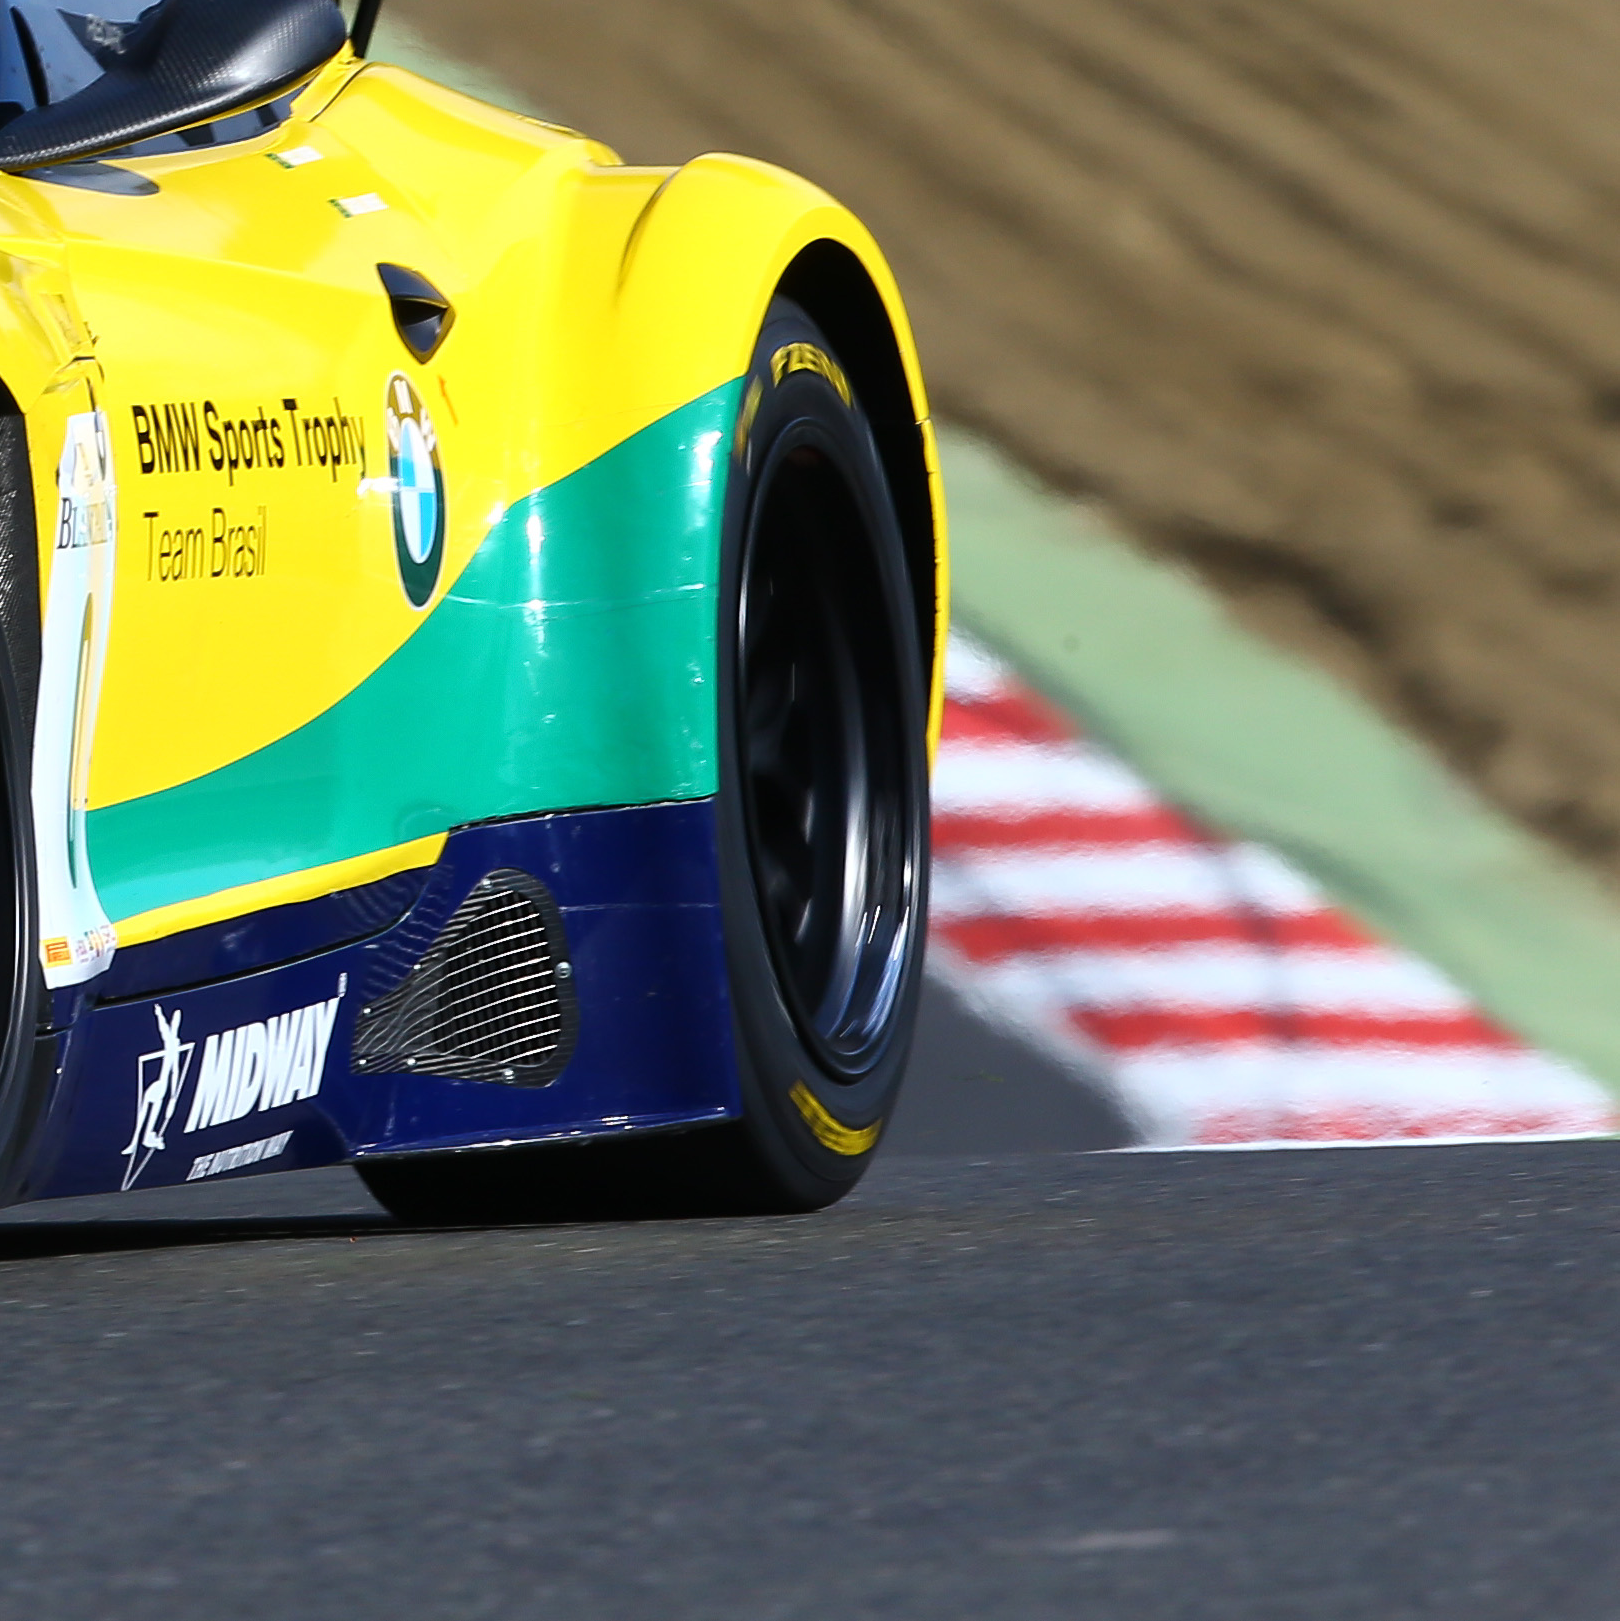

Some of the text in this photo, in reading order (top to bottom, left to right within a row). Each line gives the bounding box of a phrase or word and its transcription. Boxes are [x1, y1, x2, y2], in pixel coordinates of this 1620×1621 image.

[131, 396, 367, 487] BMW Sports Trophy
[142, 511, 205, 582] Team
[208, 505, 267, 578] Brasil
[183, 996, 341, 1134] MIDWAY
